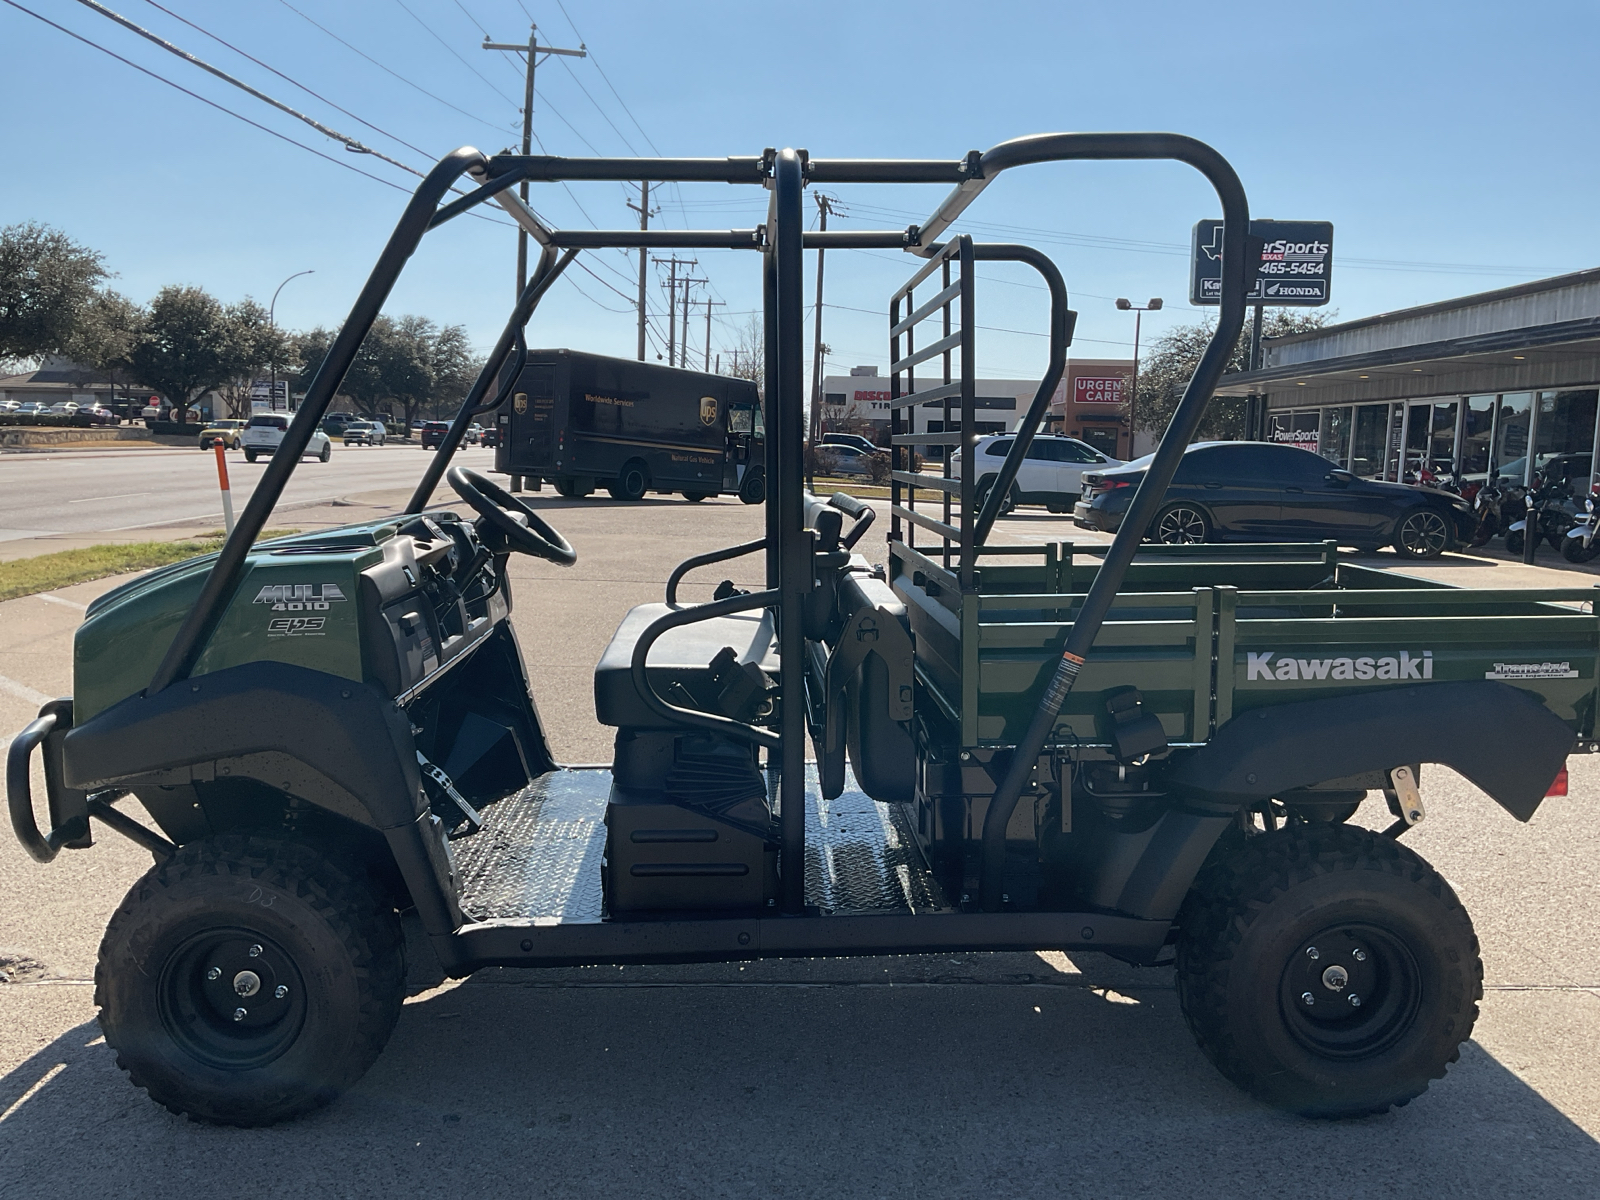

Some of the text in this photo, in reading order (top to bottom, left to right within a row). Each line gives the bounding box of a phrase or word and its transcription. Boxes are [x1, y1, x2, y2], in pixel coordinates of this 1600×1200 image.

[1262, 240, 1329, 256] erSports
[1279, 287, 1322, 296] HONDA
[1077, 380, 1121, 390] URGEN
[585, 393, 635, 407] Worldwide Services
[1086, 391, 1120, 401] CARE
[515, 399, 527, 411] ups
[702, 405, 717, 422] ups
[1274, 429, 1319, 442] PowerSports
[671, 453, 688, 462] Natural
[698, 456, 715, 465] Vehicle
[253, 584, 348, 603] MULE
[271, 602, 330, 611] 4010
[1247, 650, 1433, 681] Kawasaki
